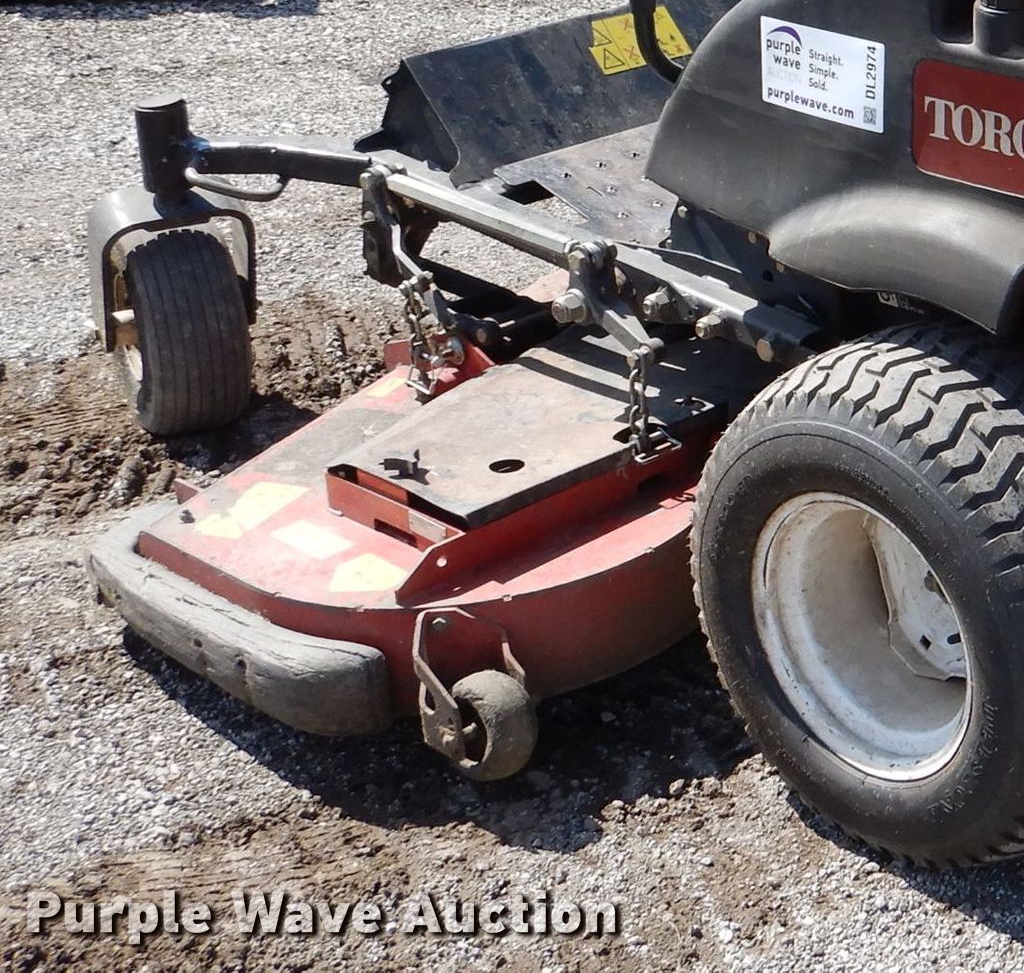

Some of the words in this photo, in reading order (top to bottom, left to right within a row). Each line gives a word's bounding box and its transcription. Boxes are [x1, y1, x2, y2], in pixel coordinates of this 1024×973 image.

[766, 39, 801, 55] purple
[773, 54, 801, 69] wave
[809, 49, 843, 66] Straight.
[809, 64, 839, 79] Simple.
[865, 46, 877, 100] DL2974
[809, 78, 828, 91] Sold.
[767, 87, 854, 119] purplewave.com
